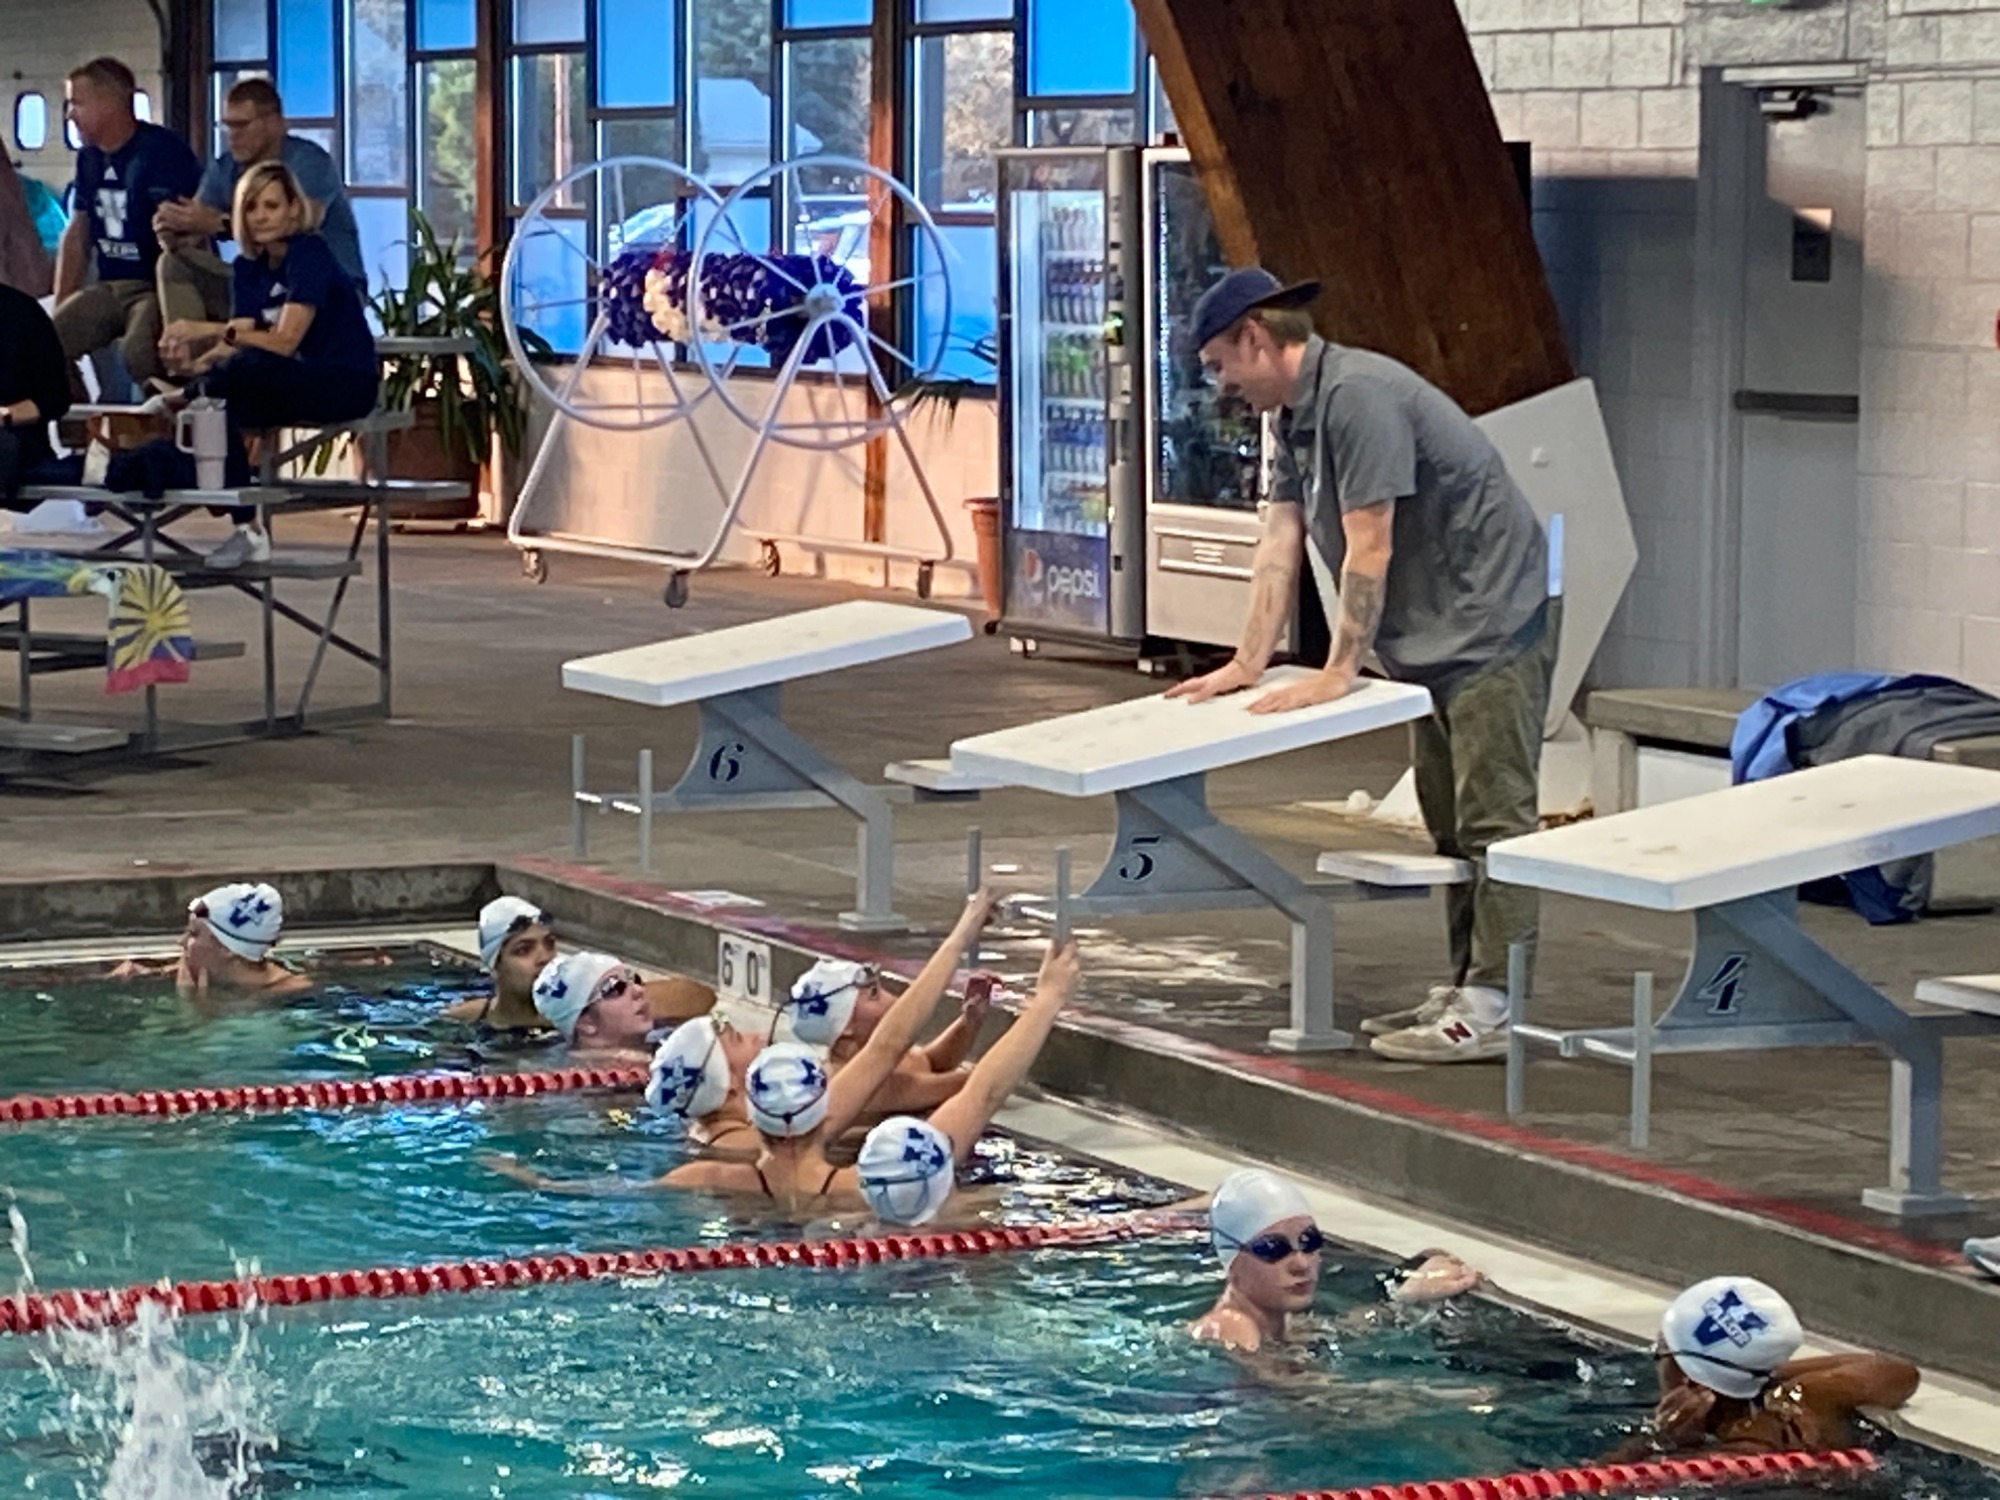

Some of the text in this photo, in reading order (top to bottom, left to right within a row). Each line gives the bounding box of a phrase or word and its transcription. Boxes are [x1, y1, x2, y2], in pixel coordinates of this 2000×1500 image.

[1047, 564, 1101, 605] pepsi
[709, 743, 744, 782] 6
[1119, 835, 1161, 880] 5
[1697, 955, 1744, 1013] 4
[1442, 1020, 1472, 1043] N
